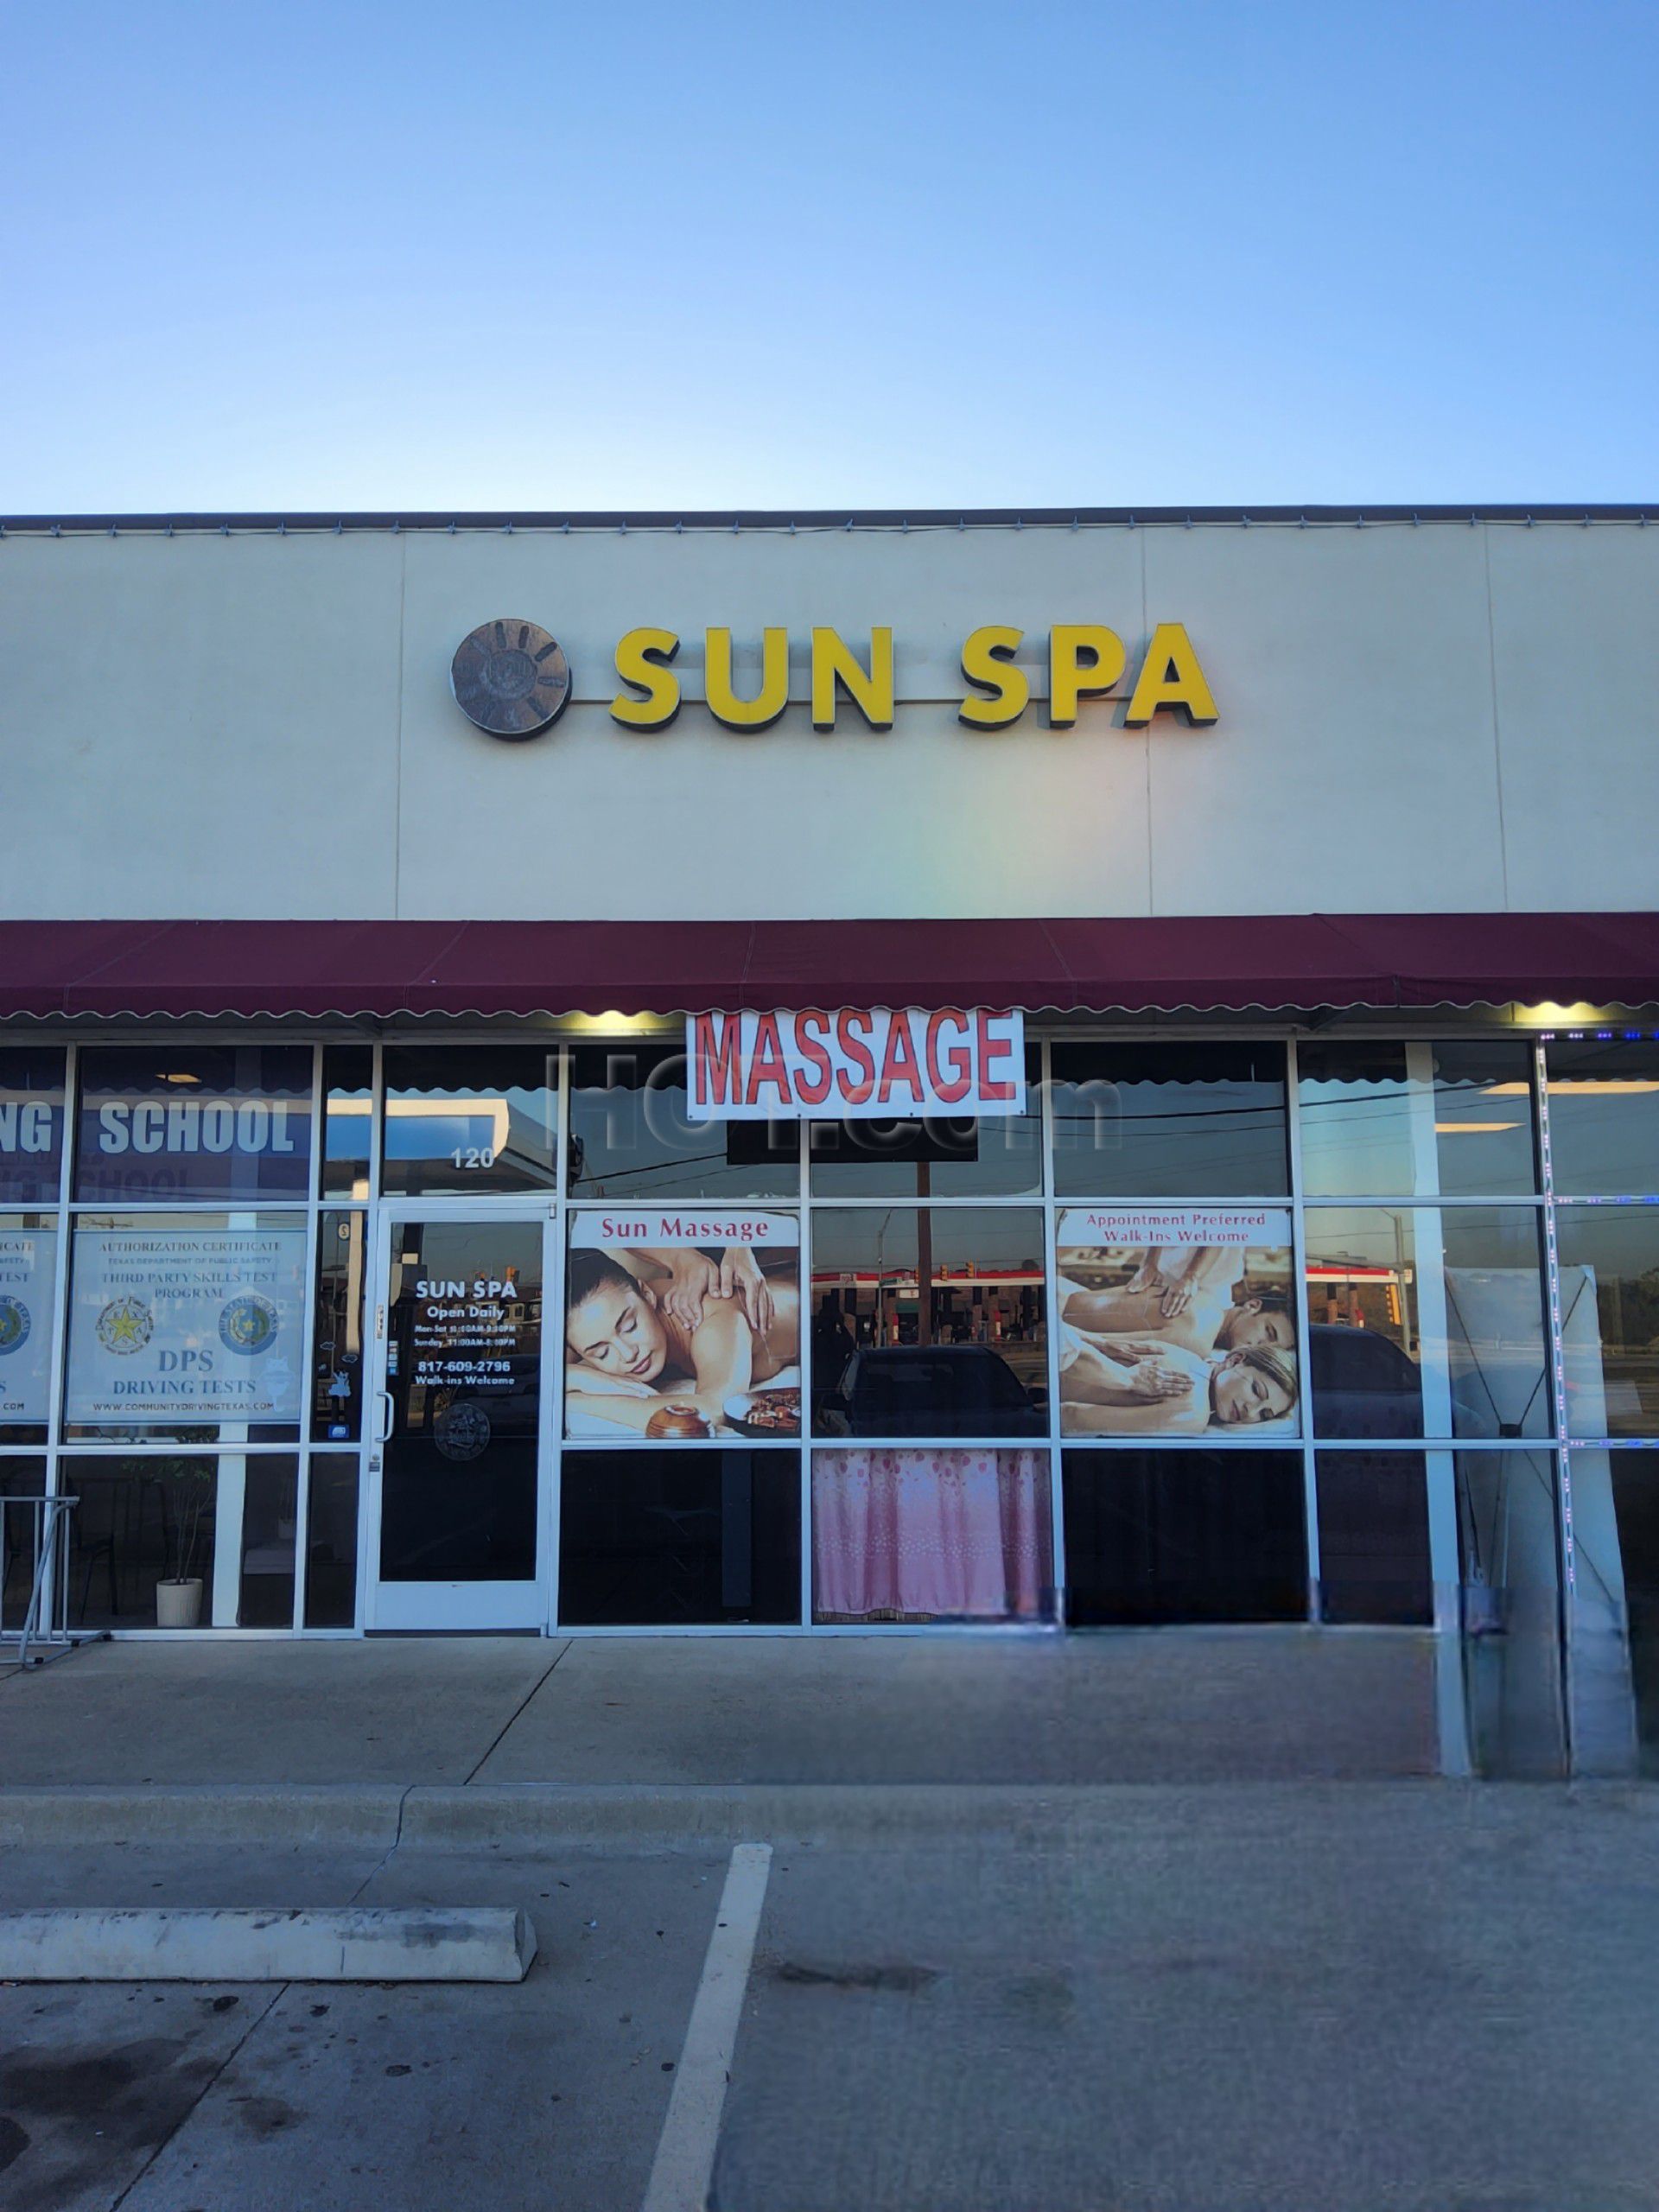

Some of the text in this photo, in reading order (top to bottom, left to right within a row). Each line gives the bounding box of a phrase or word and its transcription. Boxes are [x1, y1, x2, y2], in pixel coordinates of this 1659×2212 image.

[607, 623, 1219, 730] SUN SPA
[695, 1008, 1017, 1104] MASSAGE
[99, 1100, 295, 1154] SCHOOL
[451, 1147, 494, 1168] 120
[1086, 1212, 1267, 1228] Appointment Preferred
[601, 1217, 769, 1242] Sun Massage
[1103, 1230, 1249, 1243] Walk-Ins Welcome
[99, 1242, 283, 1253] AUTHORIZATION CERTIFICATE
[103, 1272, 278, 1284] THIRD PARTY SKILLS TEST
[155, 1288, 223, 1300] PROGRAM
[416, 1280, 518, 1299] SUN SPA
[427, 1305, 505, 1321] Open Daily
[158, 1350, 214, 1373] DPS
[418, 1361, 512, 1373] 817-609-2796
[113, 1380, 257, 1395] DRIVING TESTS
[465, 1375, 516, 1386] Welcome
